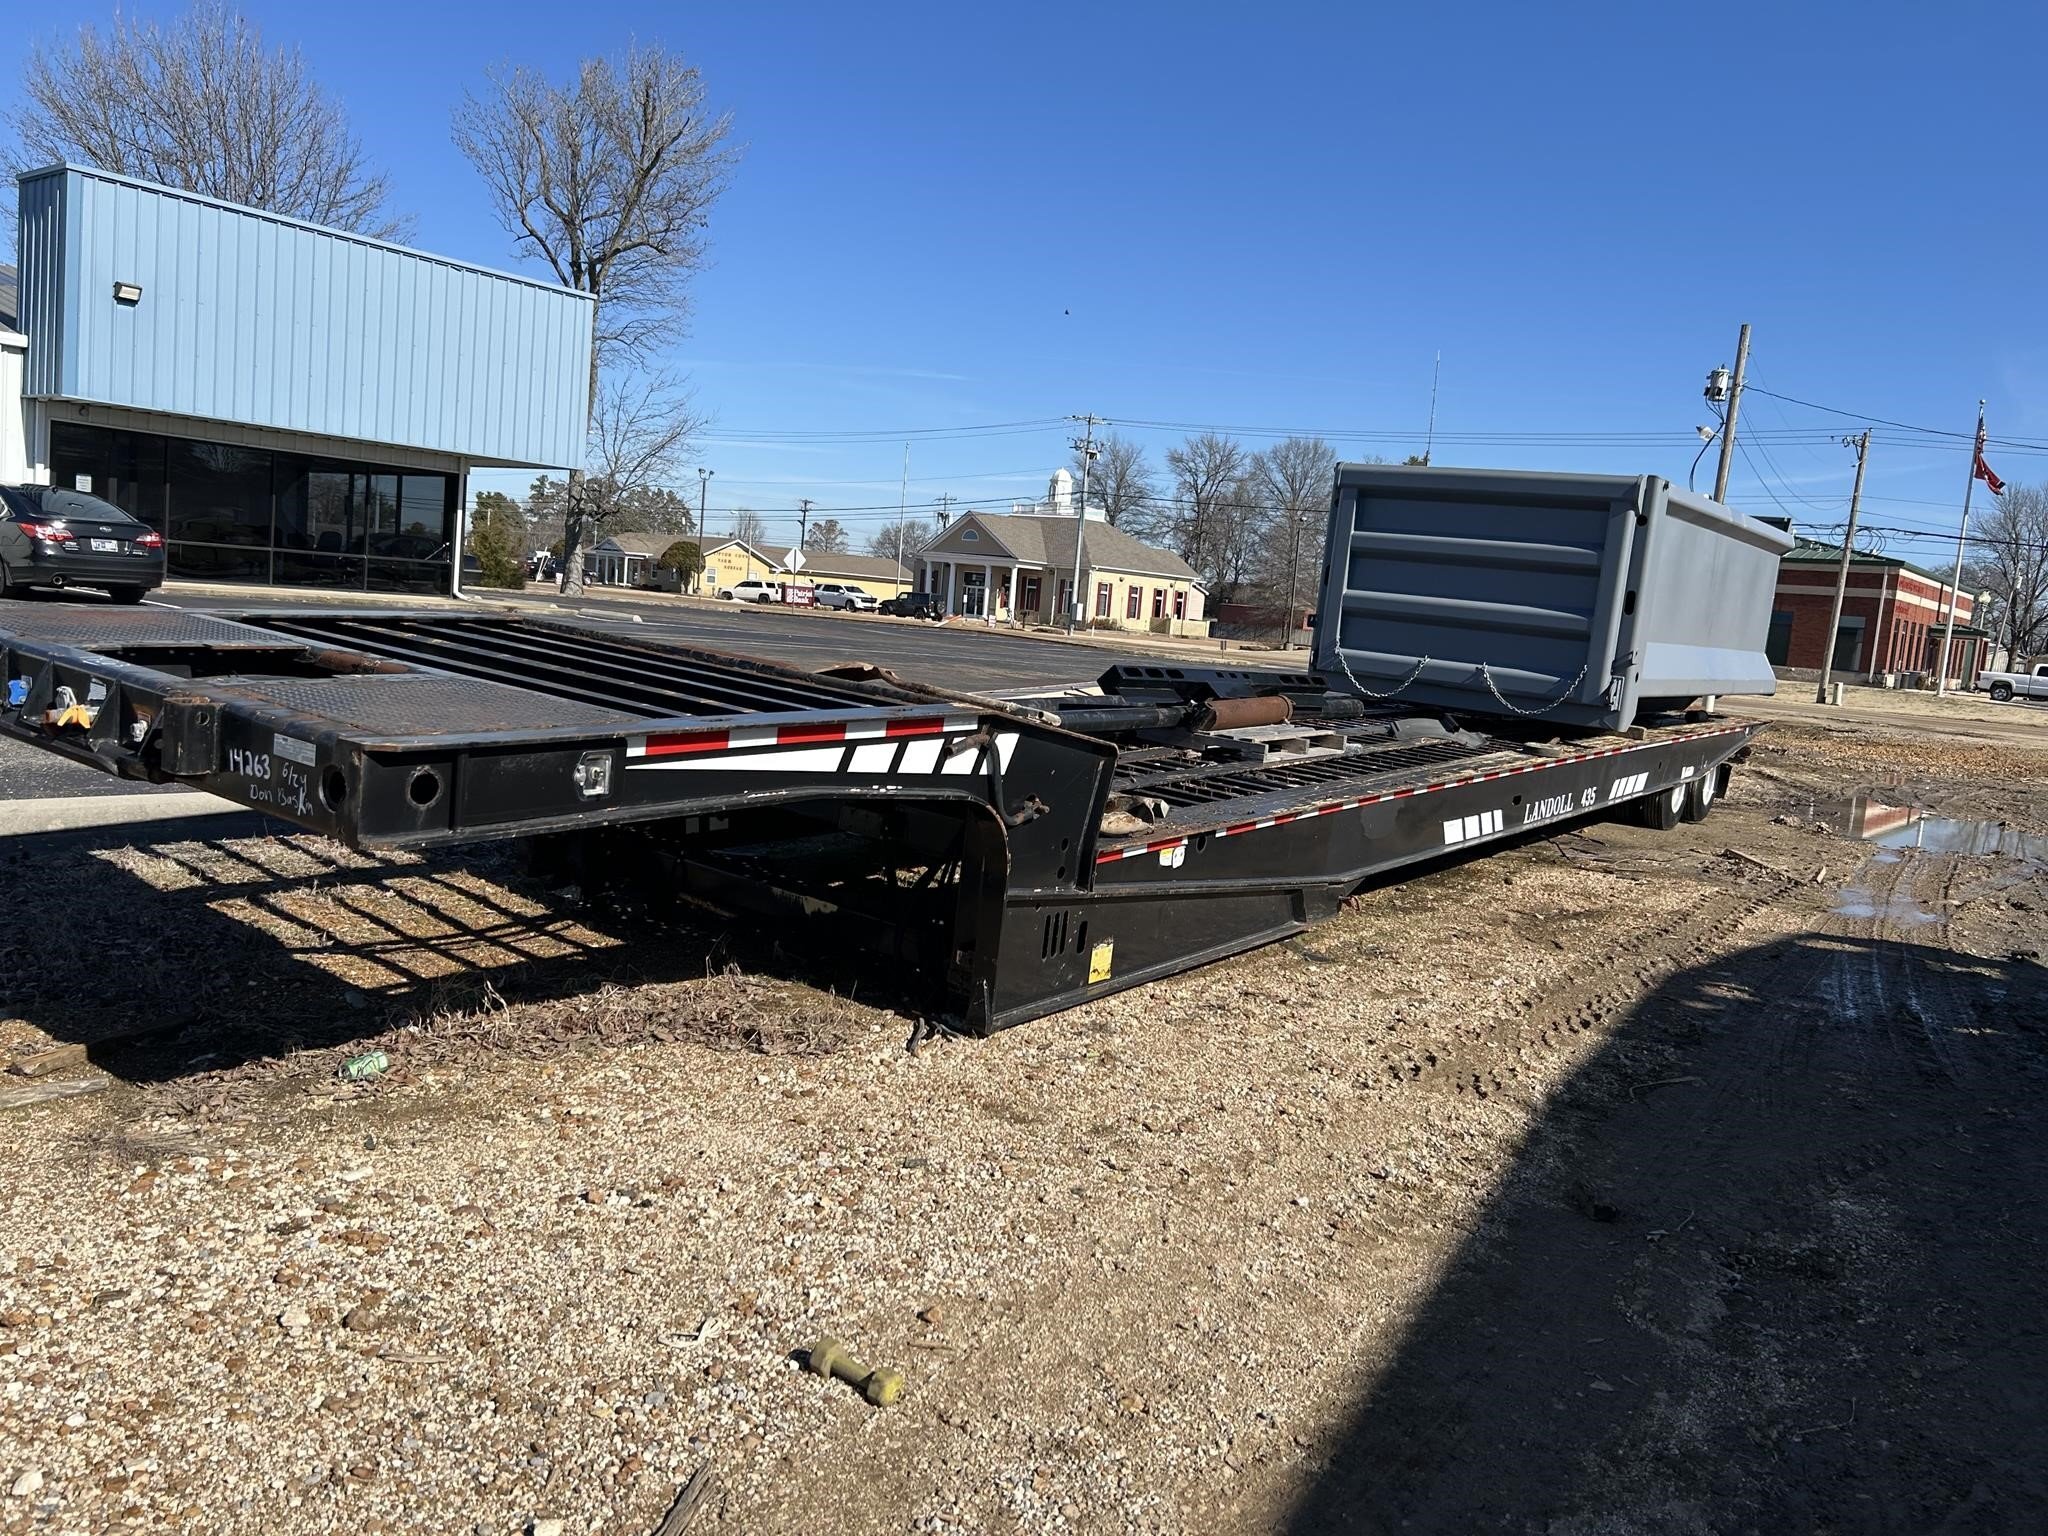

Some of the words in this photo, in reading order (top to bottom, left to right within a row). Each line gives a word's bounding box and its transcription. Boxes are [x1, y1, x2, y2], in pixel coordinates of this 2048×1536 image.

[229, 748, 271, 780] 14263
[249, 783, 273, 803] Don
[1522, 792, 1574, 825] LANDOLL
[1580, 786, 1597, 808] 435
